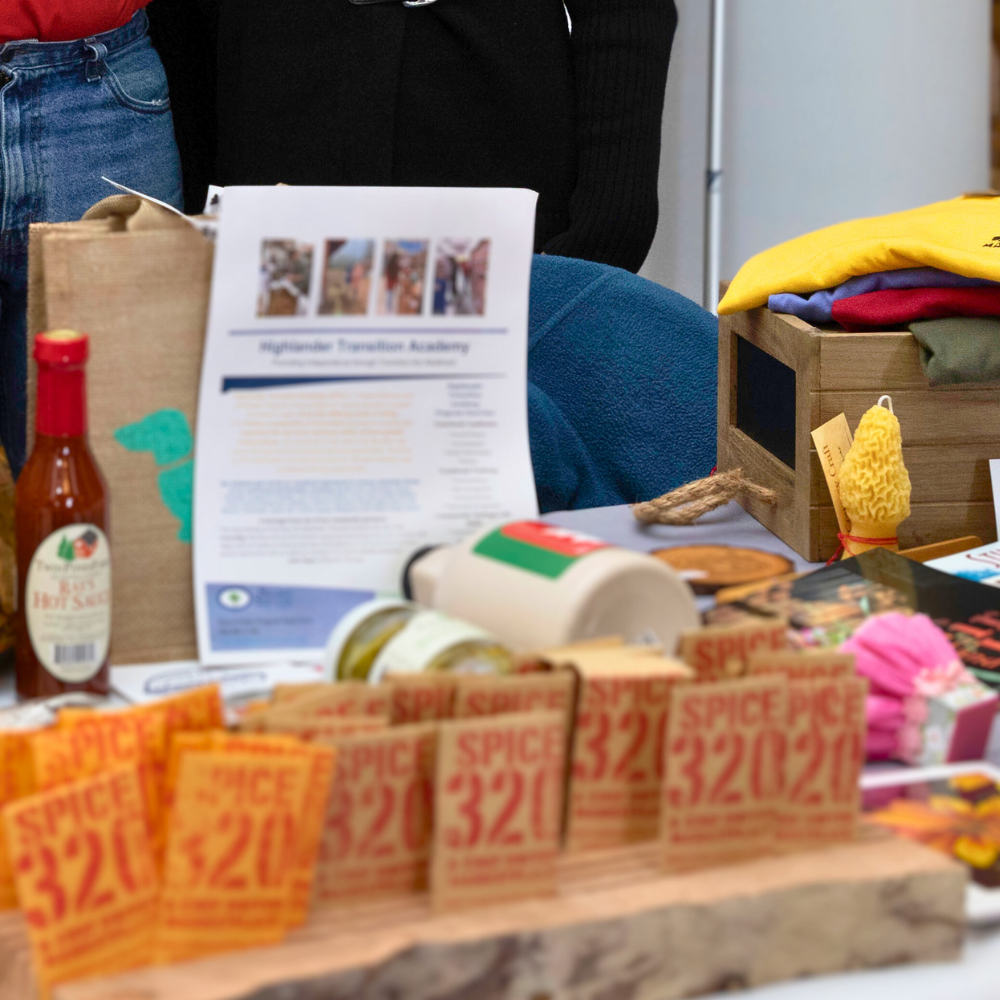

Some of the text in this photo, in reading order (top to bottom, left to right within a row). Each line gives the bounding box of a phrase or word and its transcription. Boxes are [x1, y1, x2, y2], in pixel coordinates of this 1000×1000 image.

[823, 444, 837, 477] Craft
[681, 687, 785, 730] SPICE
[458, 724, 564, 768] SPICE
[667, 728, 788, 807] 320
